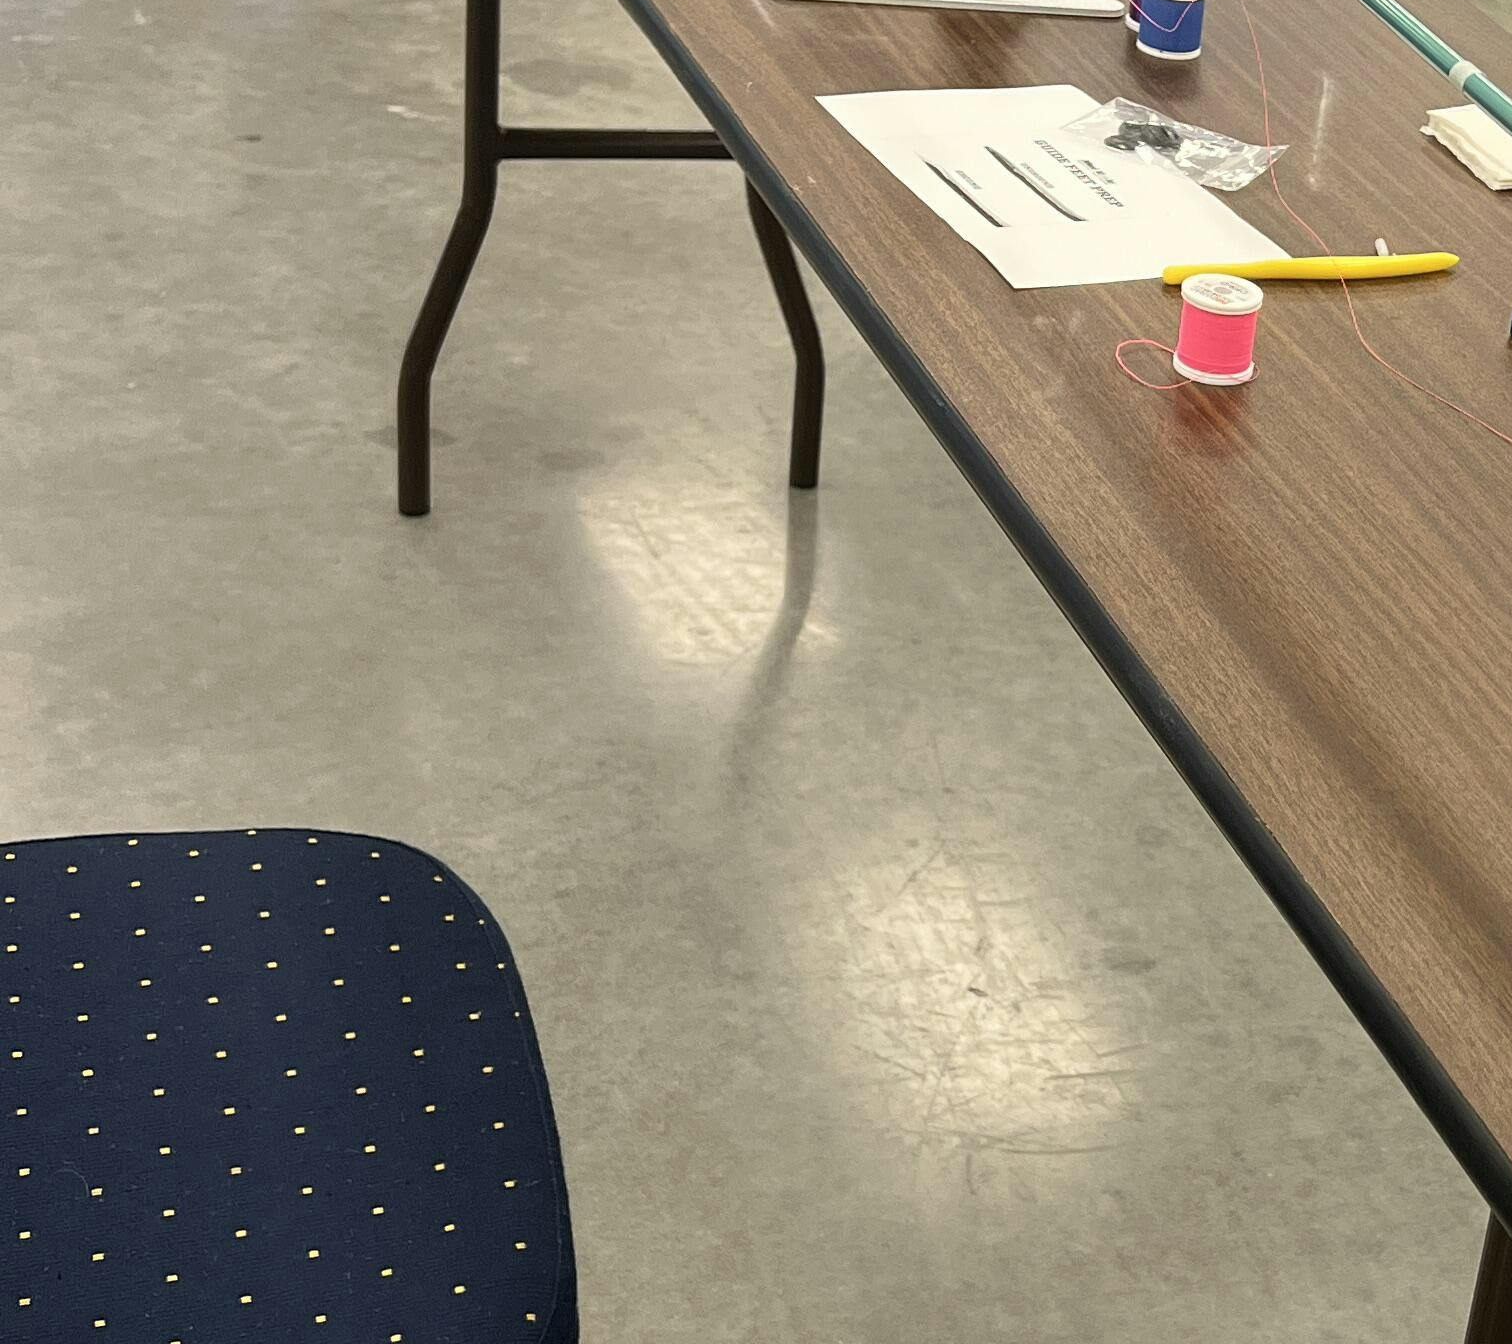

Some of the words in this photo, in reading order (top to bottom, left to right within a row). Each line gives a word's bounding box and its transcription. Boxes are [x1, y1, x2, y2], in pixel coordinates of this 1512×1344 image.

[1034, 139, 1069, 163] GUIDE
[1065, 164, 1097, 185] FEET
[1092, 186, 1125, 207] PREP
